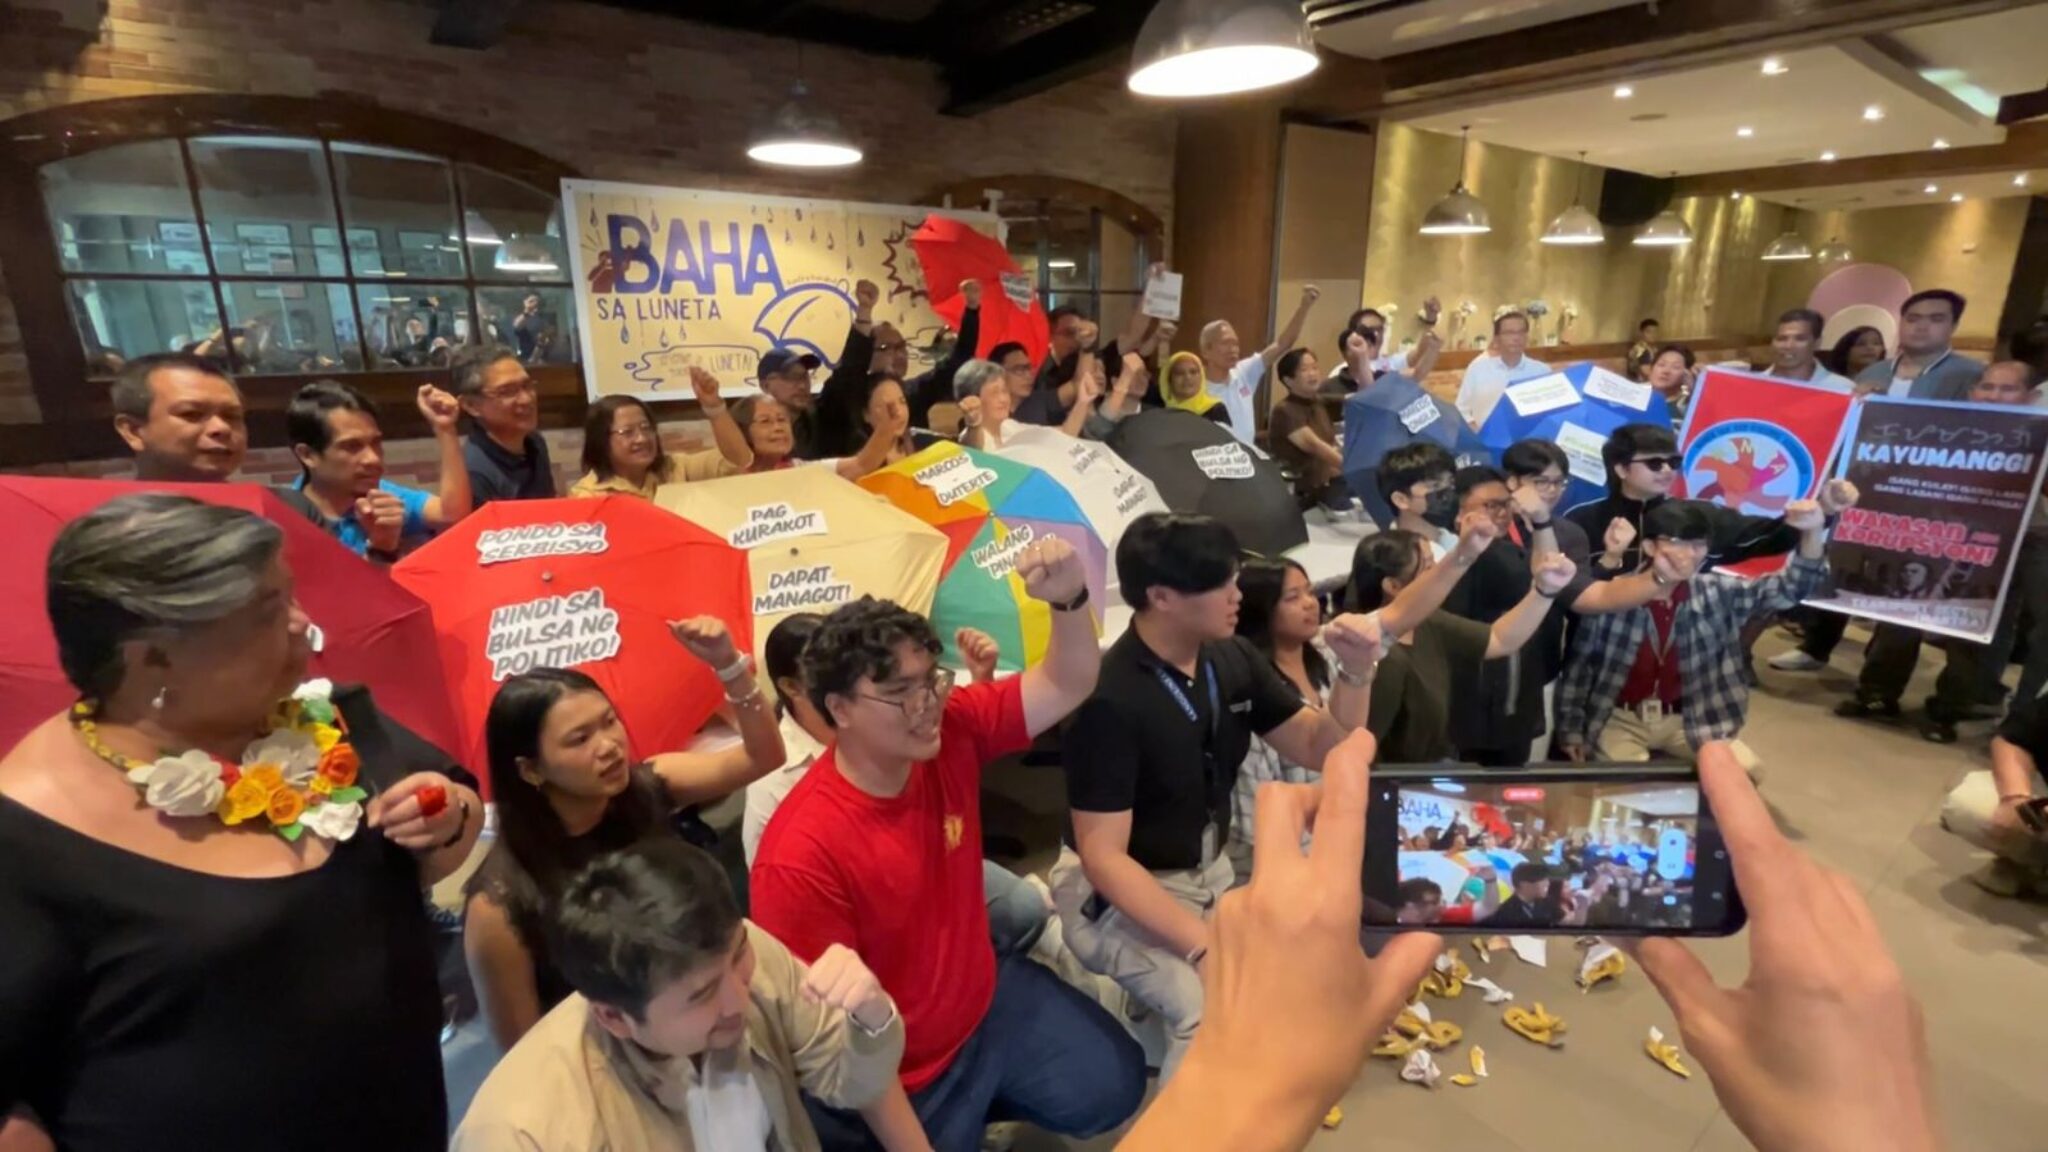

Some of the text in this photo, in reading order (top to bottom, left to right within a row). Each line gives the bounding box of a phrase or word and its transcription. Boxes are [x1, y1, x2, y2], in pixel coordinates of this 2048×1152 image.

[607, 214, 785, 297] BAHA
[596, 298, 722, 321] SA LUNETA
[915, 456, 969, 481] MARCOS
[1857, 442, 2035, 474] KAYUMANGGI
[939, 471, 993, 503] DUTERTE
[733, 513, 816, 545] KURAKOT
[751, 505, 787, 521] PAG
[480, 523, 604, 546] PONDO SA
[482, 540, 605, 560] SERBISYO
[972, 525, 1031, 564] WALANG
[1833, 522, 1998, 567] KORUPSYON!
[769, 566, 830, 590] DAPAT
[492, 590, 600, 629] HINDI SA
[755, 584, 850, 612] MANAGOT!
[488, 613, 614, 655] BULSA NG
[495, 635, 617, 678] POLITIKO!
